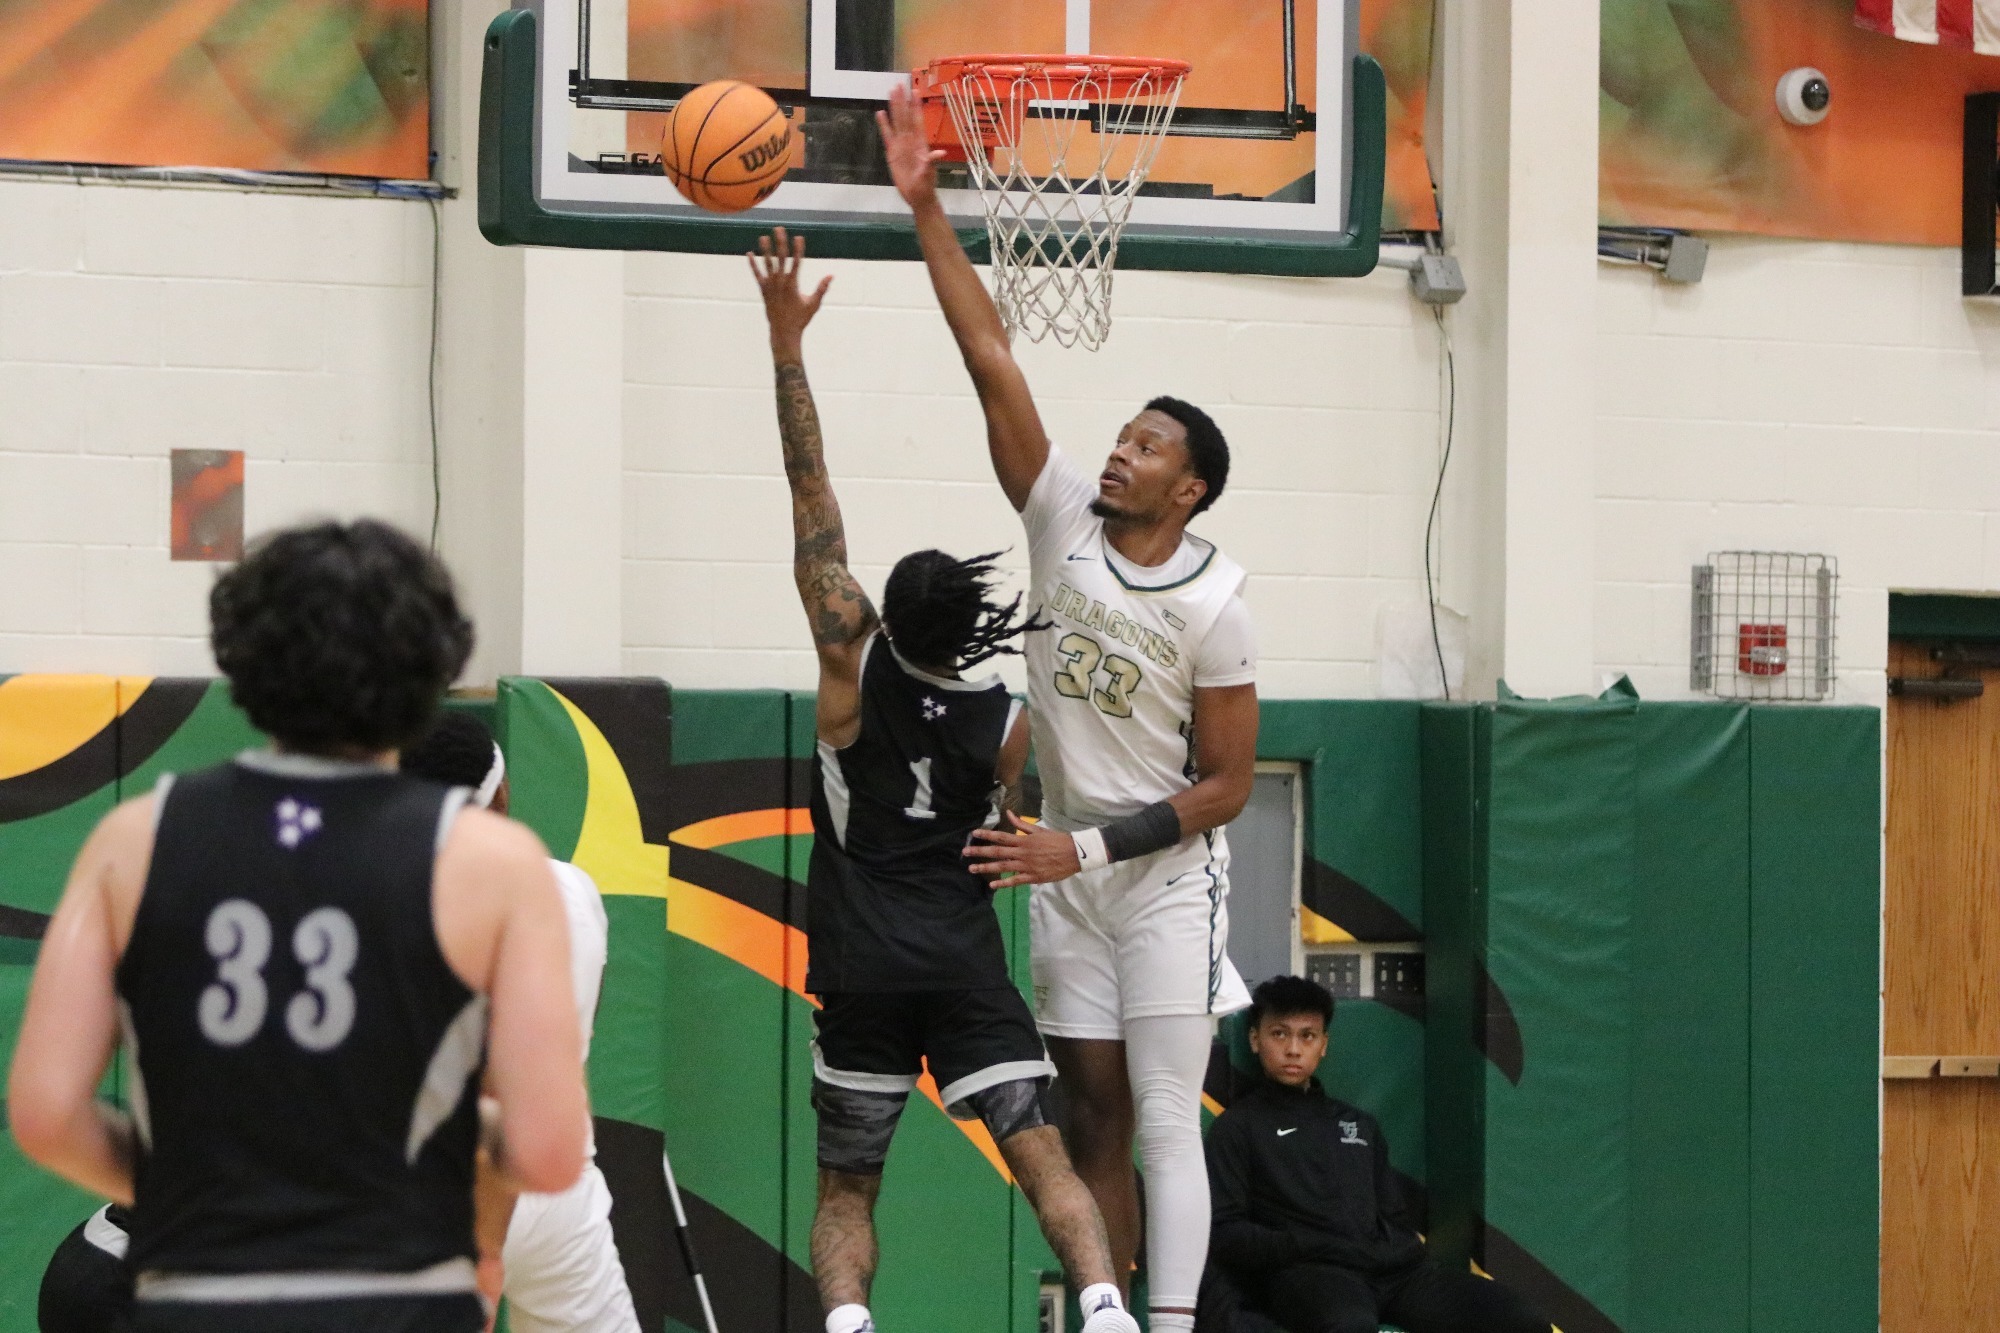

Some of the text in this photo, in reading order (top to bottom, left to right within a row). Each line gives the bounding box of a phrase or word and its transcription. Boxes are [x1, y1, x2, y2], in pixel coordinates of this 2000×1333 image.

[1051, 583, 1179, 668] DRAGONS
[1054, 632, 1142, 719] 33
[903, 756, 937, 820] 1
[197, 898, 359, 1052] 33
